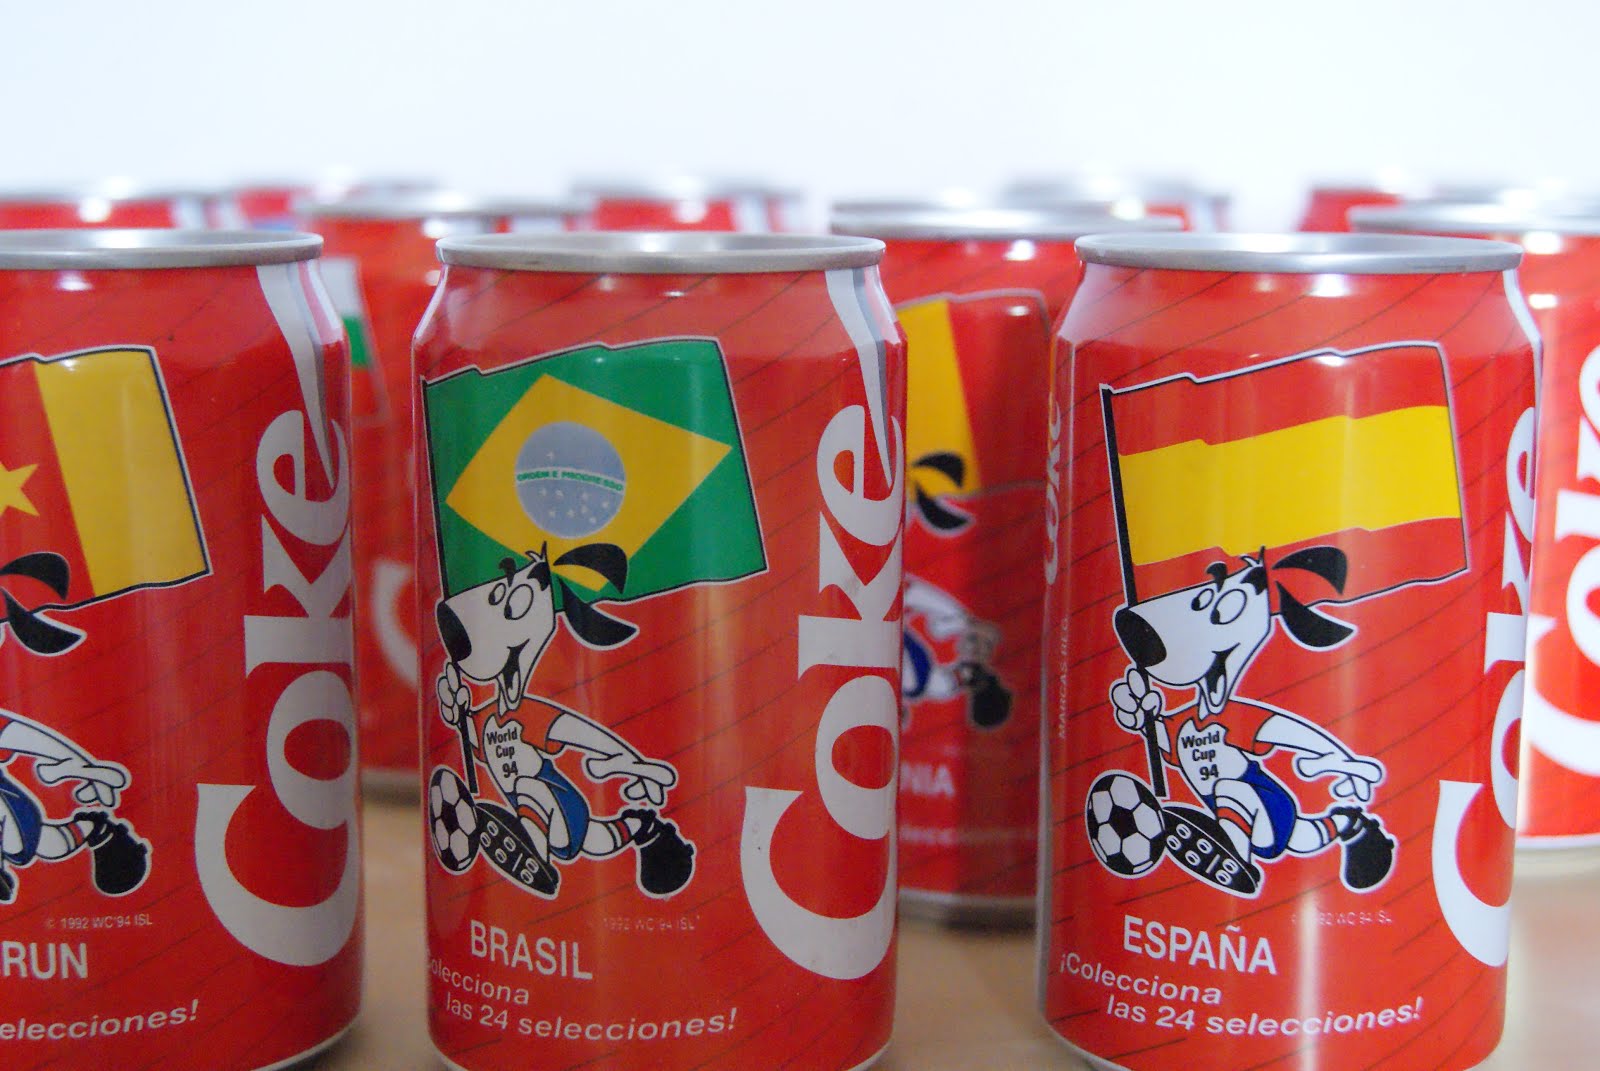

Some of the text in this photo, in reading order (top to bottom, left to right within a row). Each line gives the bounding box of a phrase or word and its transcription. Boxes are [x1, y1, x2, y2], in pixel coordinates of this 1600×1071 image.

[195, 409, 360, 966] Coke
[740, 404, 903, 980] Coke
[486, 727, 518, 745] World
[496, 745, 515, 759] Cup
[1181, 730, 1220, 749] World
[1192, 748, 1216, 762] Cup
[502, 760, 518, 778] 94
[1200, 764, 1219, 781] 94
[60, 916, 89, 930] 1992
[134, 913, 153, 926] ISL
[1, 941, 88, 979] RUN
[470, 919, 593, 980] BRASIL
[1123, 914, 1277, 975] ESPAÑA
[429, 958, 530, 1005] olecciona
[1059, 952, 1222, 1005] ¡Colecciona
[446, 991, 738, 1041] las 24 selecciones!
[1107, 994, 1423, 1036] las 24 selecciones!
